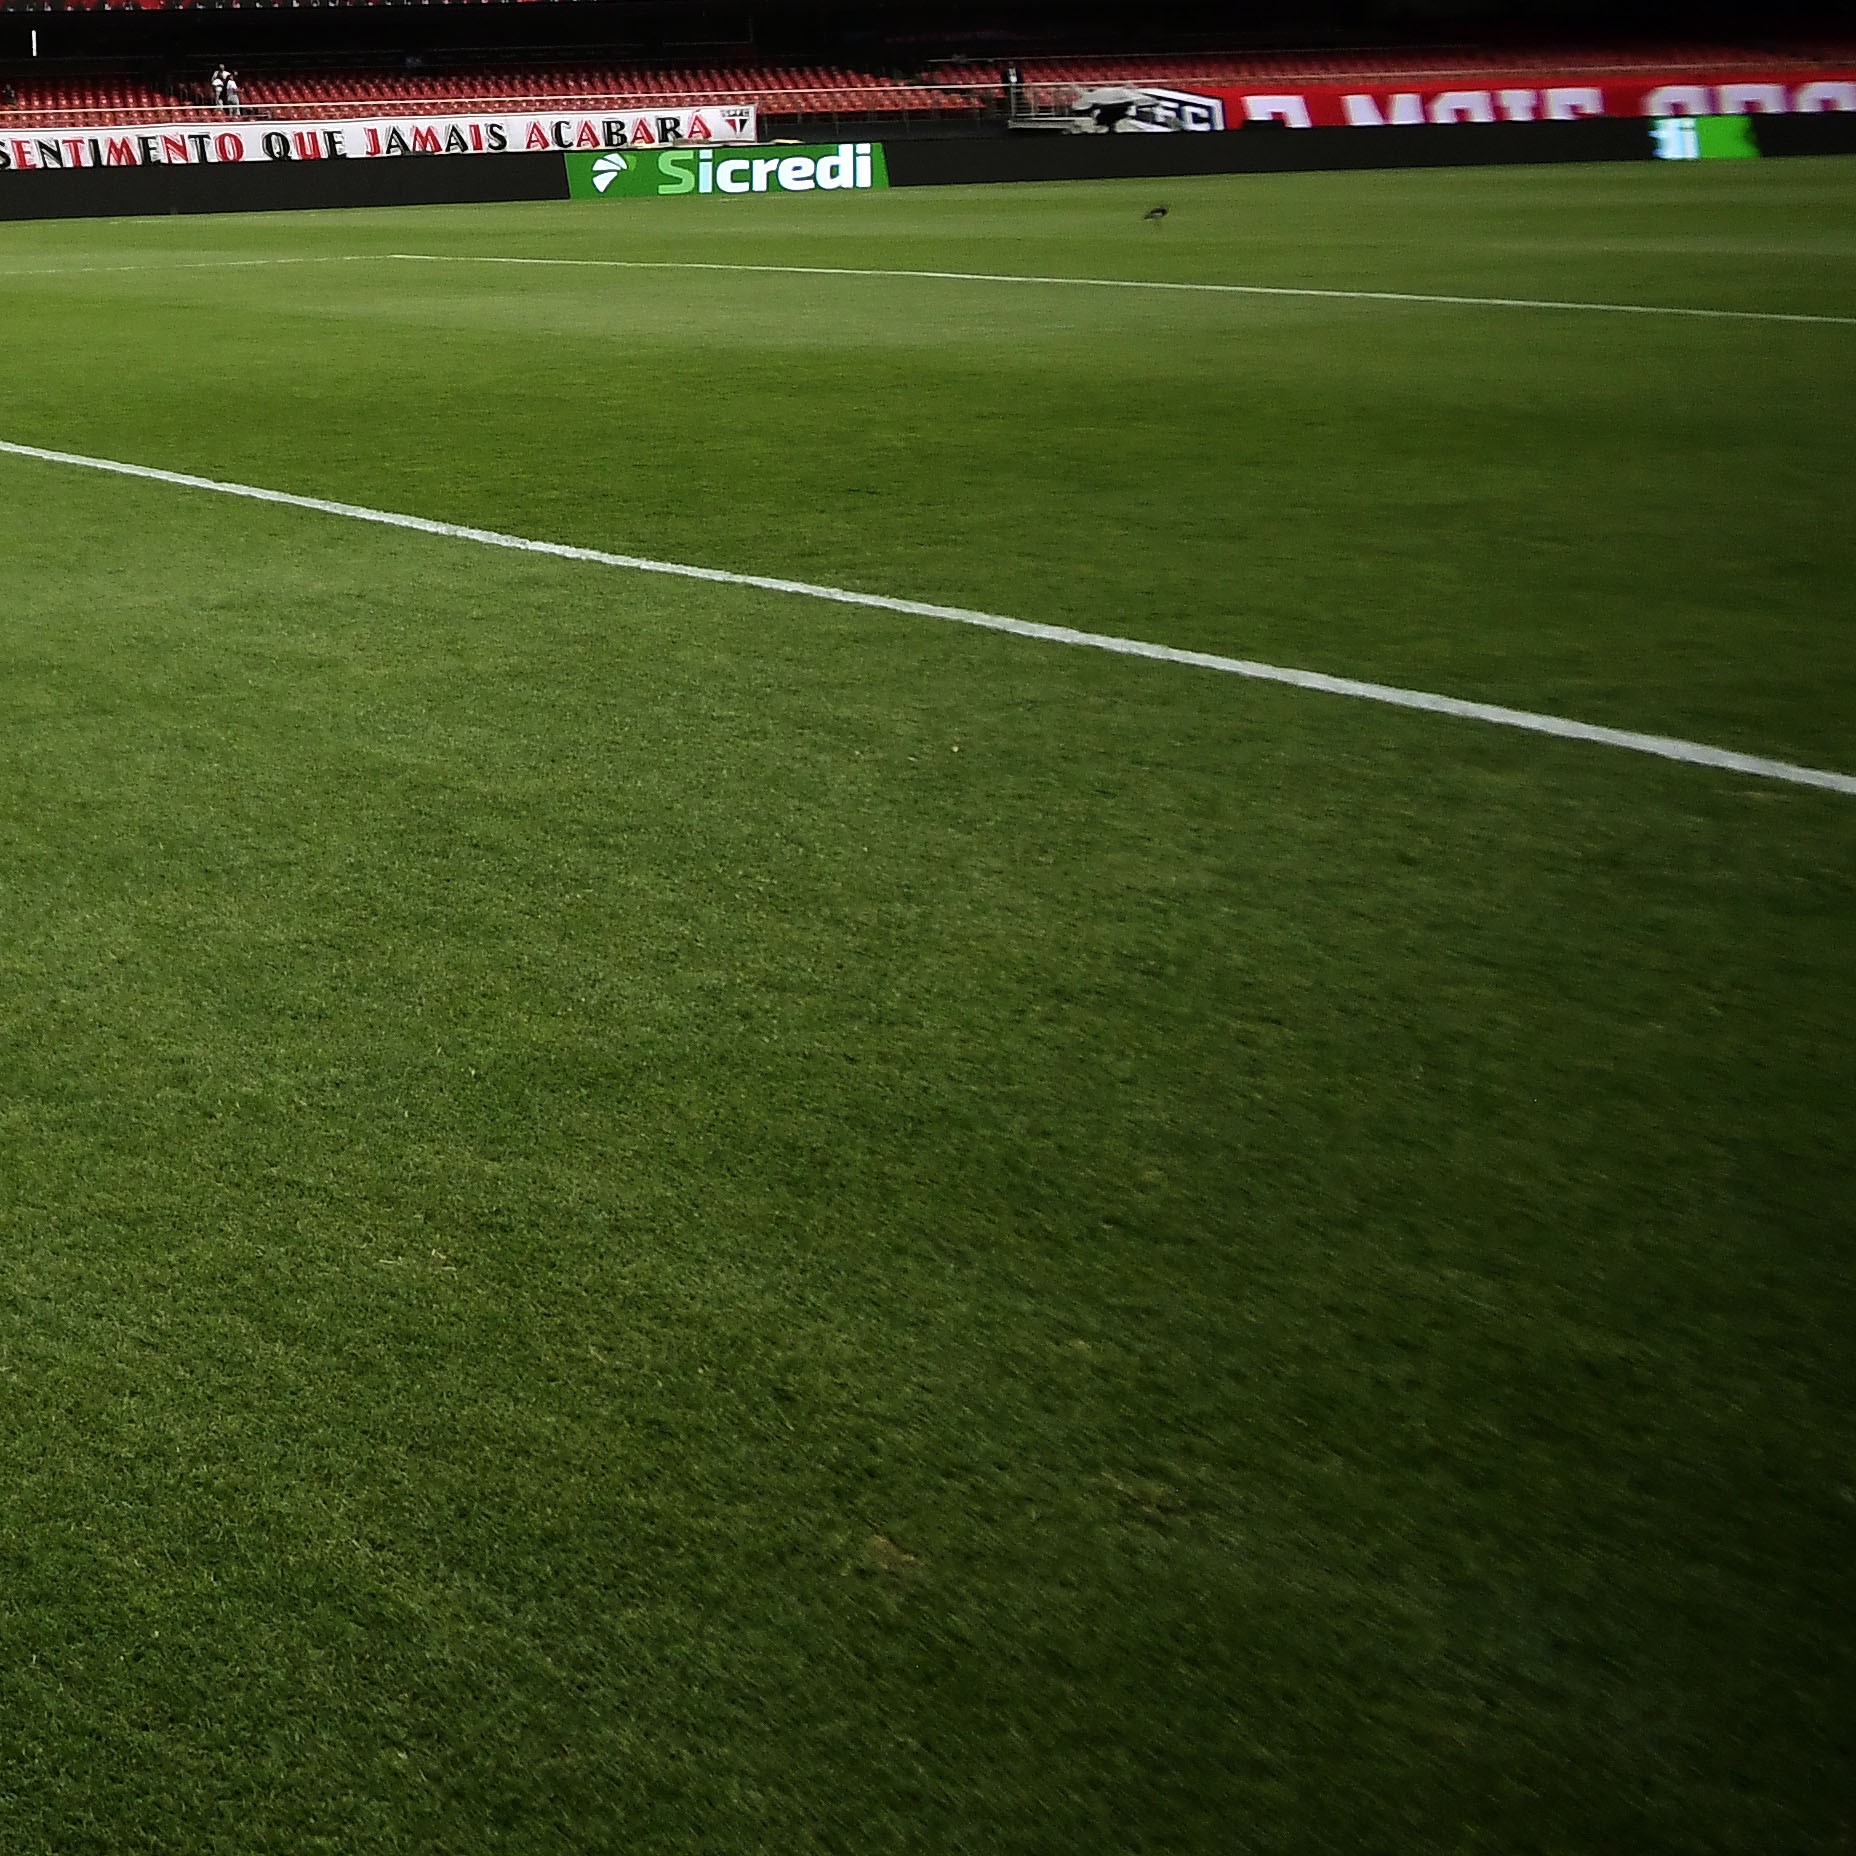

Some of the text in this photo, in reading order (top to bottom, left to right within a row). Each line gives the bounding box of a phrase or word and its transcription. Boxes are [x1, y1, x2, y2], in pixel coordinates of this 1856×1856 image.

[262, 128, 346, 162] QUE
[364, 123, 508, 157] JAMAIS
[525, 110, 713, 150] ACABARÁ
[657, 143, 873, 195] Sicredi
